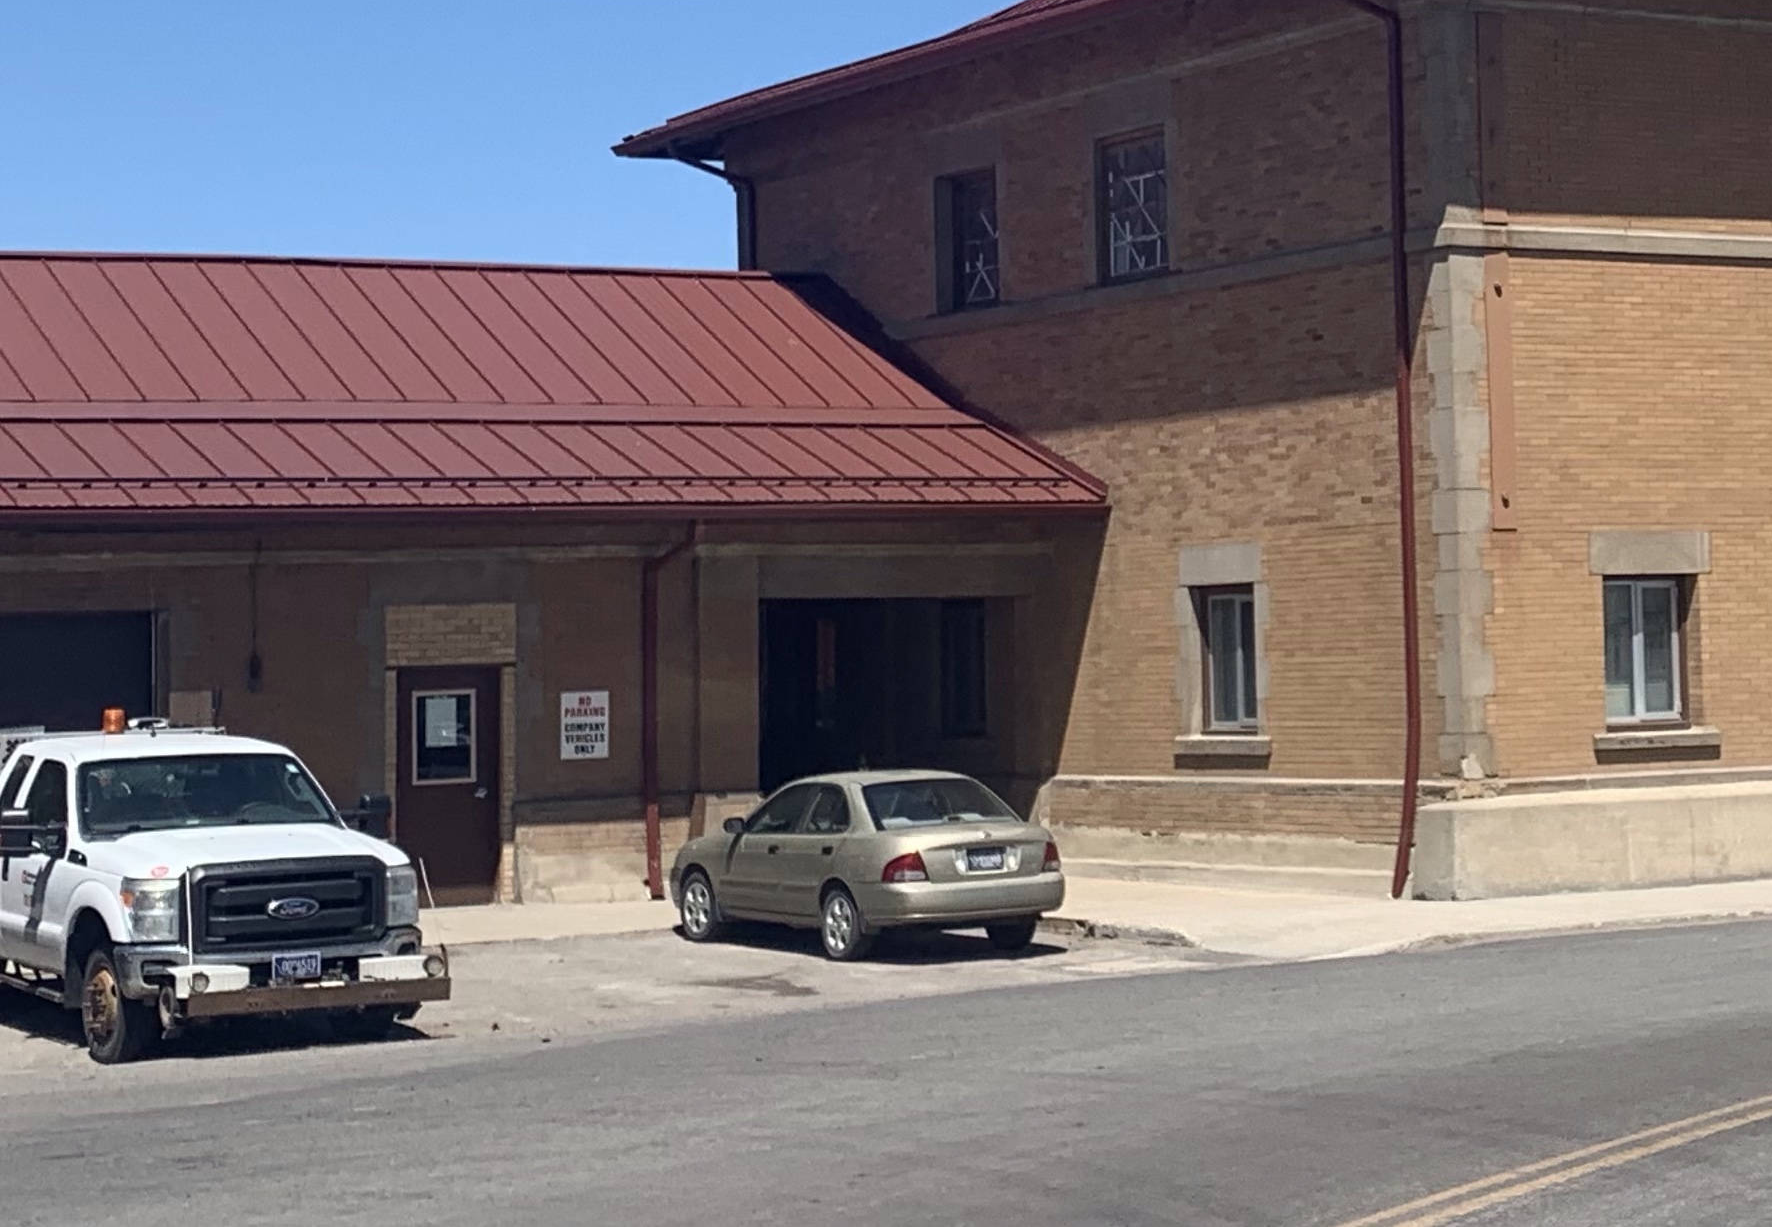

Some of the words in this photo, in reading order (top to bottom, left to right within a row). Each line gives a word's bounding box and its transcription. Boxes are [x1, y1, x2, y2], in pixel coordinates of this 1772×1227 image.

[578, 695, 592, 706] NO
[564, 706, 606, 718] PARKING
[564, 722, 606, 733] COMPANY
[564, 733, 606, 744] VEHICLES
[574, 744, 595, 755] ONLY
